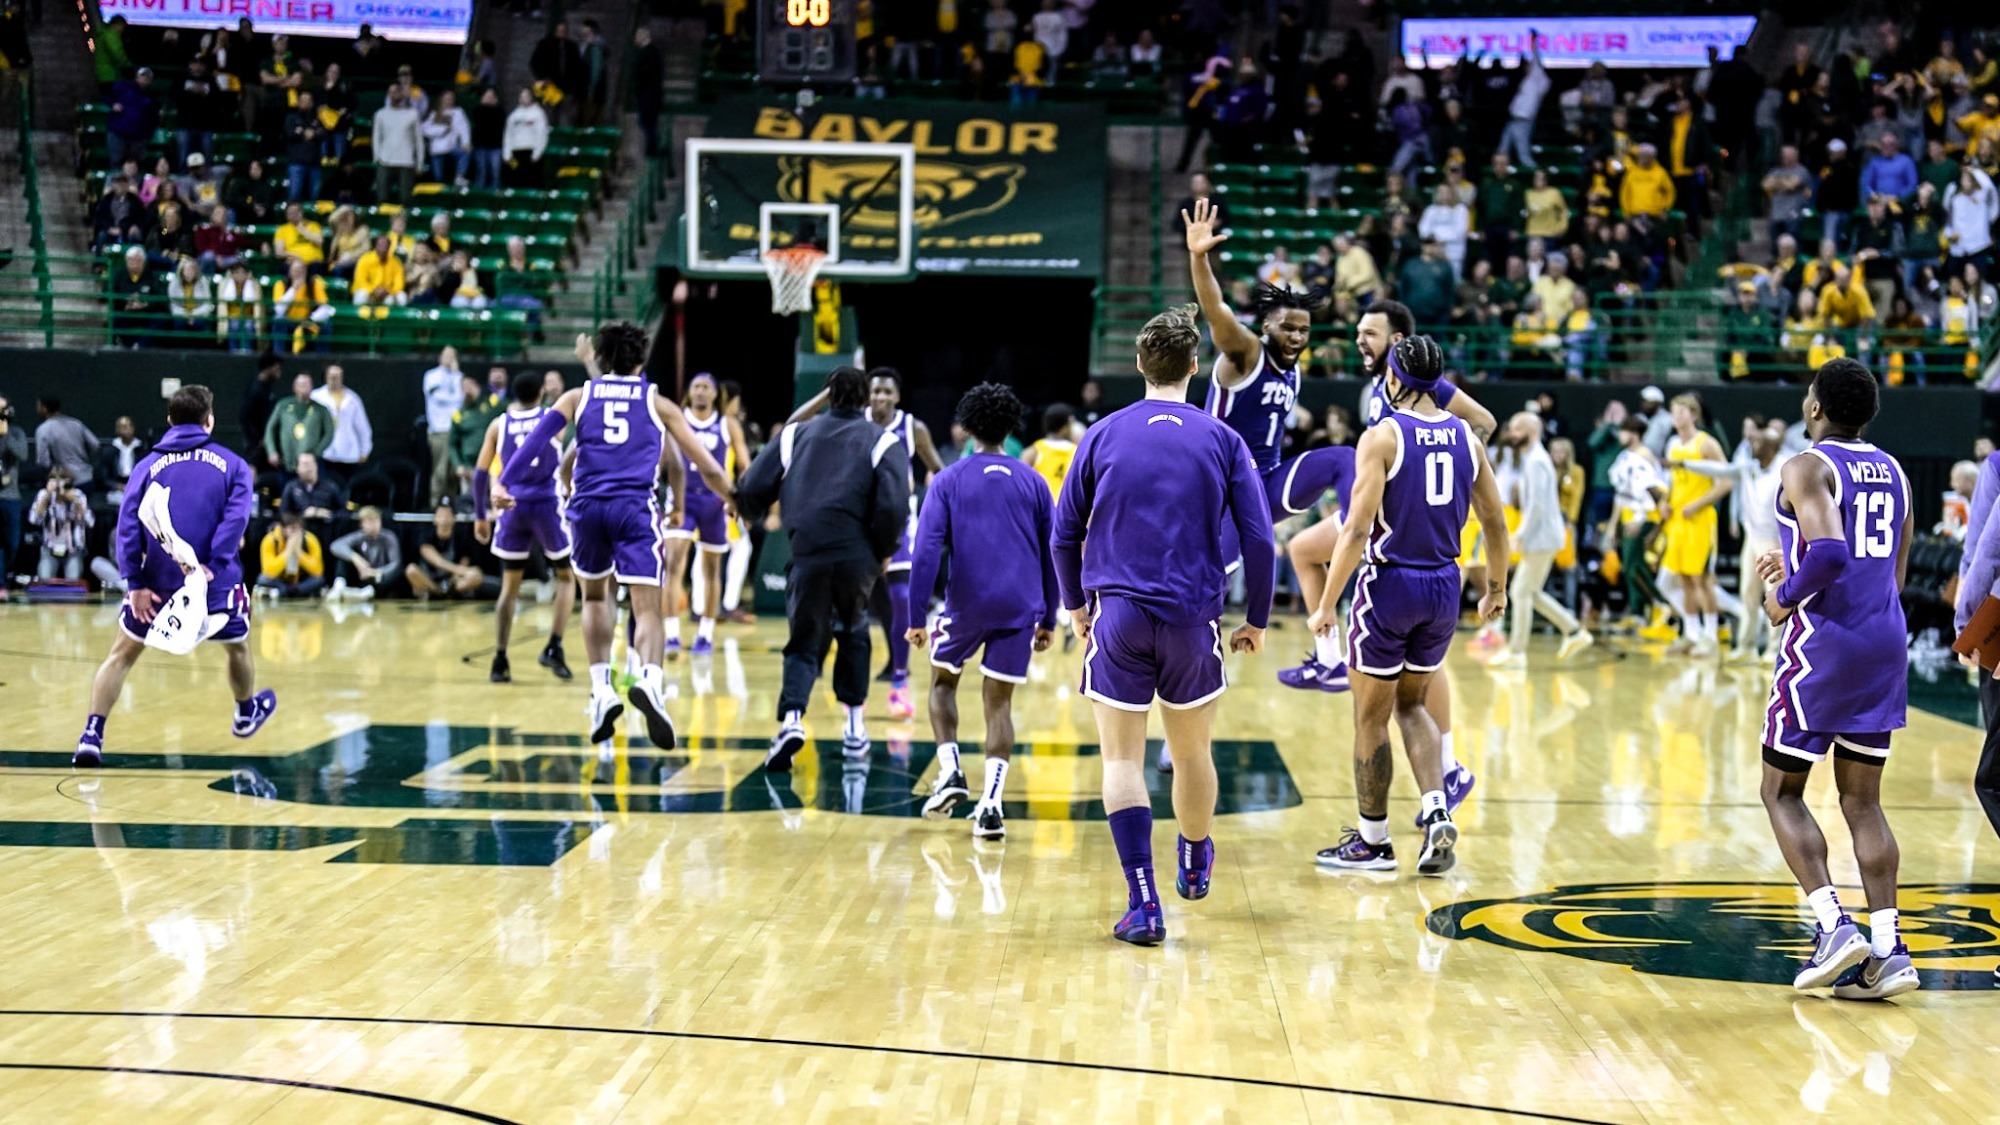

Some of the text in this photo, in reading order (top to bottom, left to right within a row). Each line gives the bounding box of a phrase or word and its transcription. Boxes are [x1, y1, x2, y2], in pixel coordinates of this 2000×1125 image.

[1480, 34, 1628, 53] TURNER
[753, 105, 1059, 155] BAYLOR
[1260, 381, 1295, 412] TCU
[603, 400, 630, 444] 5
[1265, 411, 1279, 447] 1
[1415, 427, 1457, 446] PEAVY
[149, 448, 227, 479] HORNED FROGS
[1424, 451, 1455, 507] 0
[1846, 460, 1893, 484] WELLS
[1852, 490, 1895, 559] 13
